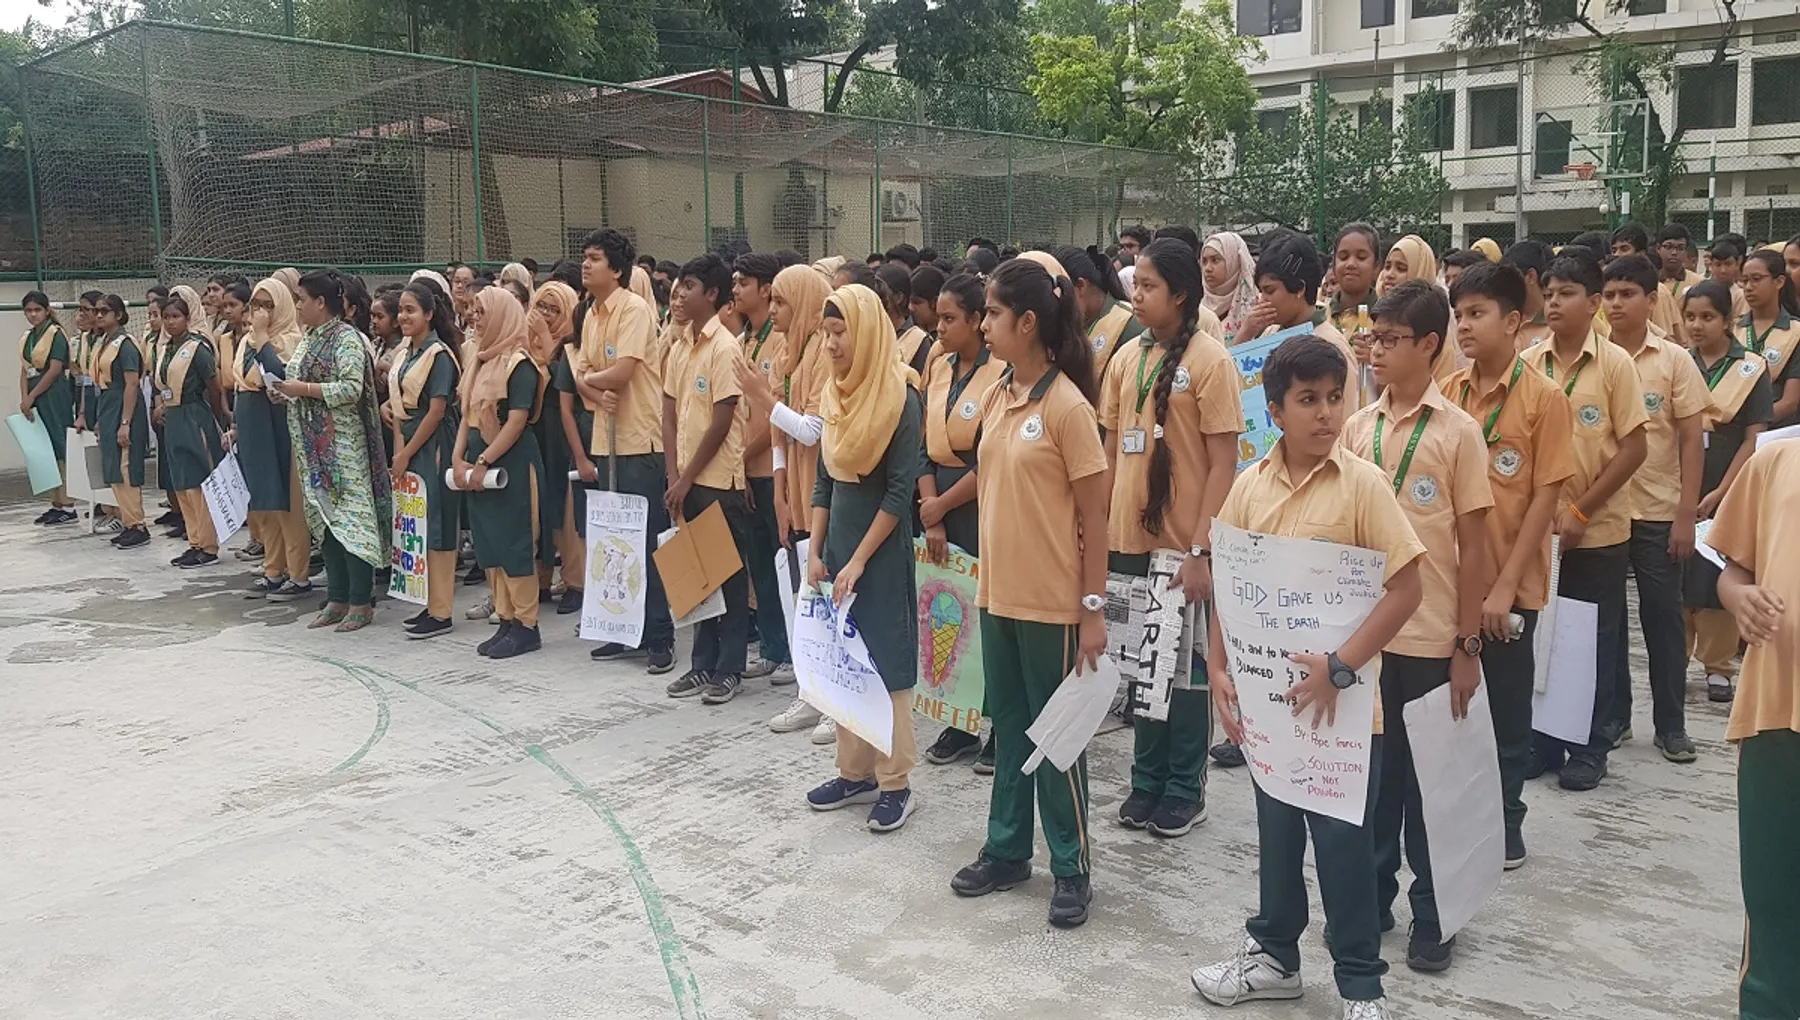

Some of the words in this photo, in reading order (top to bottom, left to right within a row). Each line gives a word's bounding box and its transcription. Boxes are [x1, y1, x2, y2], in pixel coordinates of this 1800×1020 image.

[1233, 576, 1268, 608] GOD
[1278, 587, 1313, 607] GAVE
[1324, 591, 1344, 605] US
[1256, 612, 1280, 629] THE
[1287, 616, 1320, 630] EARTH
